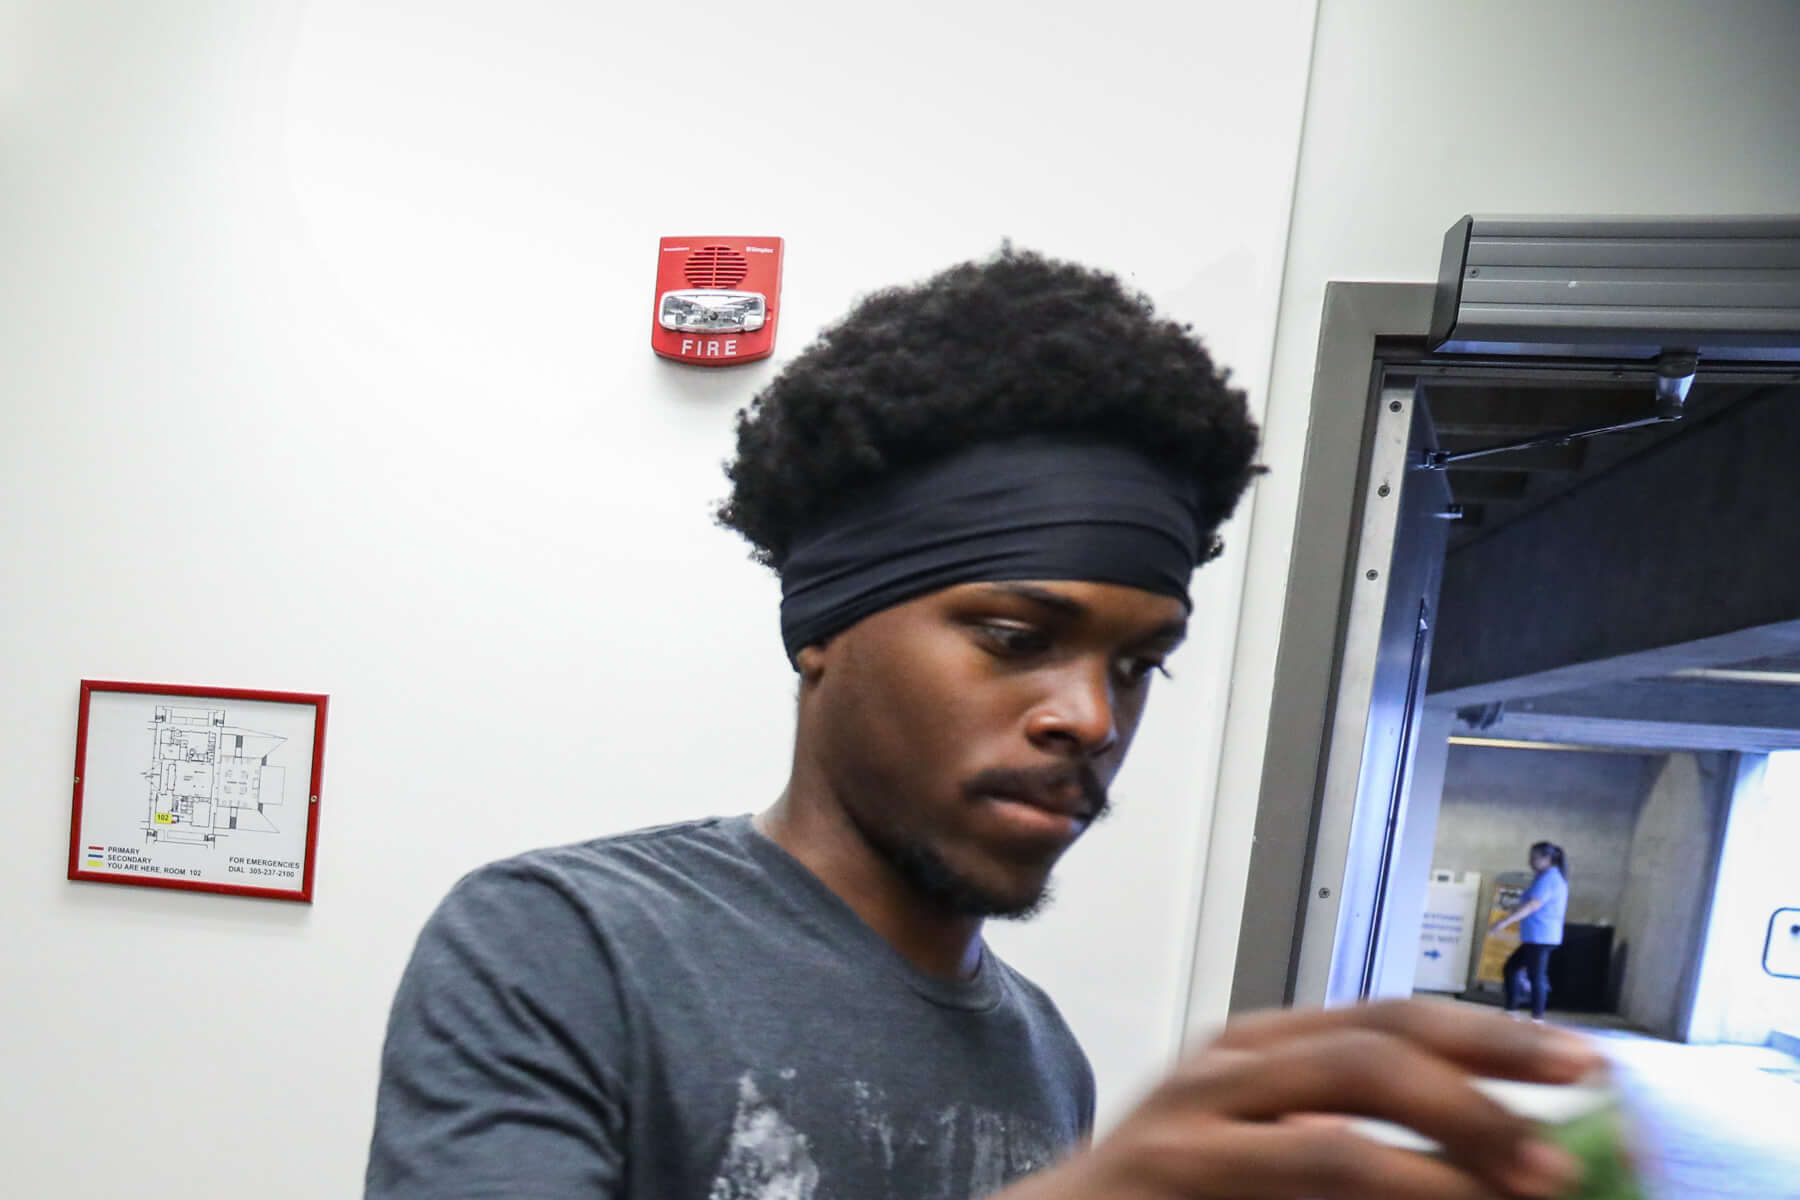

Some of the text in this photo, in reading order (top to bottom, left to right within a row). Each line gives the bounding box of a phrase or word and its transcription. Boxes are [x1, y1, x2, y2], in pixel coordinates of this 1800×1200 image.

[681, 339, 737, 357] FIRE
[157, 813, 169, 822] 102
[107, 846, 140, 857] PRIMARY
[107, 854, 153, 864] SECONDARY
[228, 856, 301, 870] FOR EMERGENCIES
[107, 861, 123, 870] YOU
[124, 863, 139, 872] ARE
[163, 866, 186, 876] ROOM
[189, 868, 202, 877] 102
[228, 865, 245, 874] DIAL
